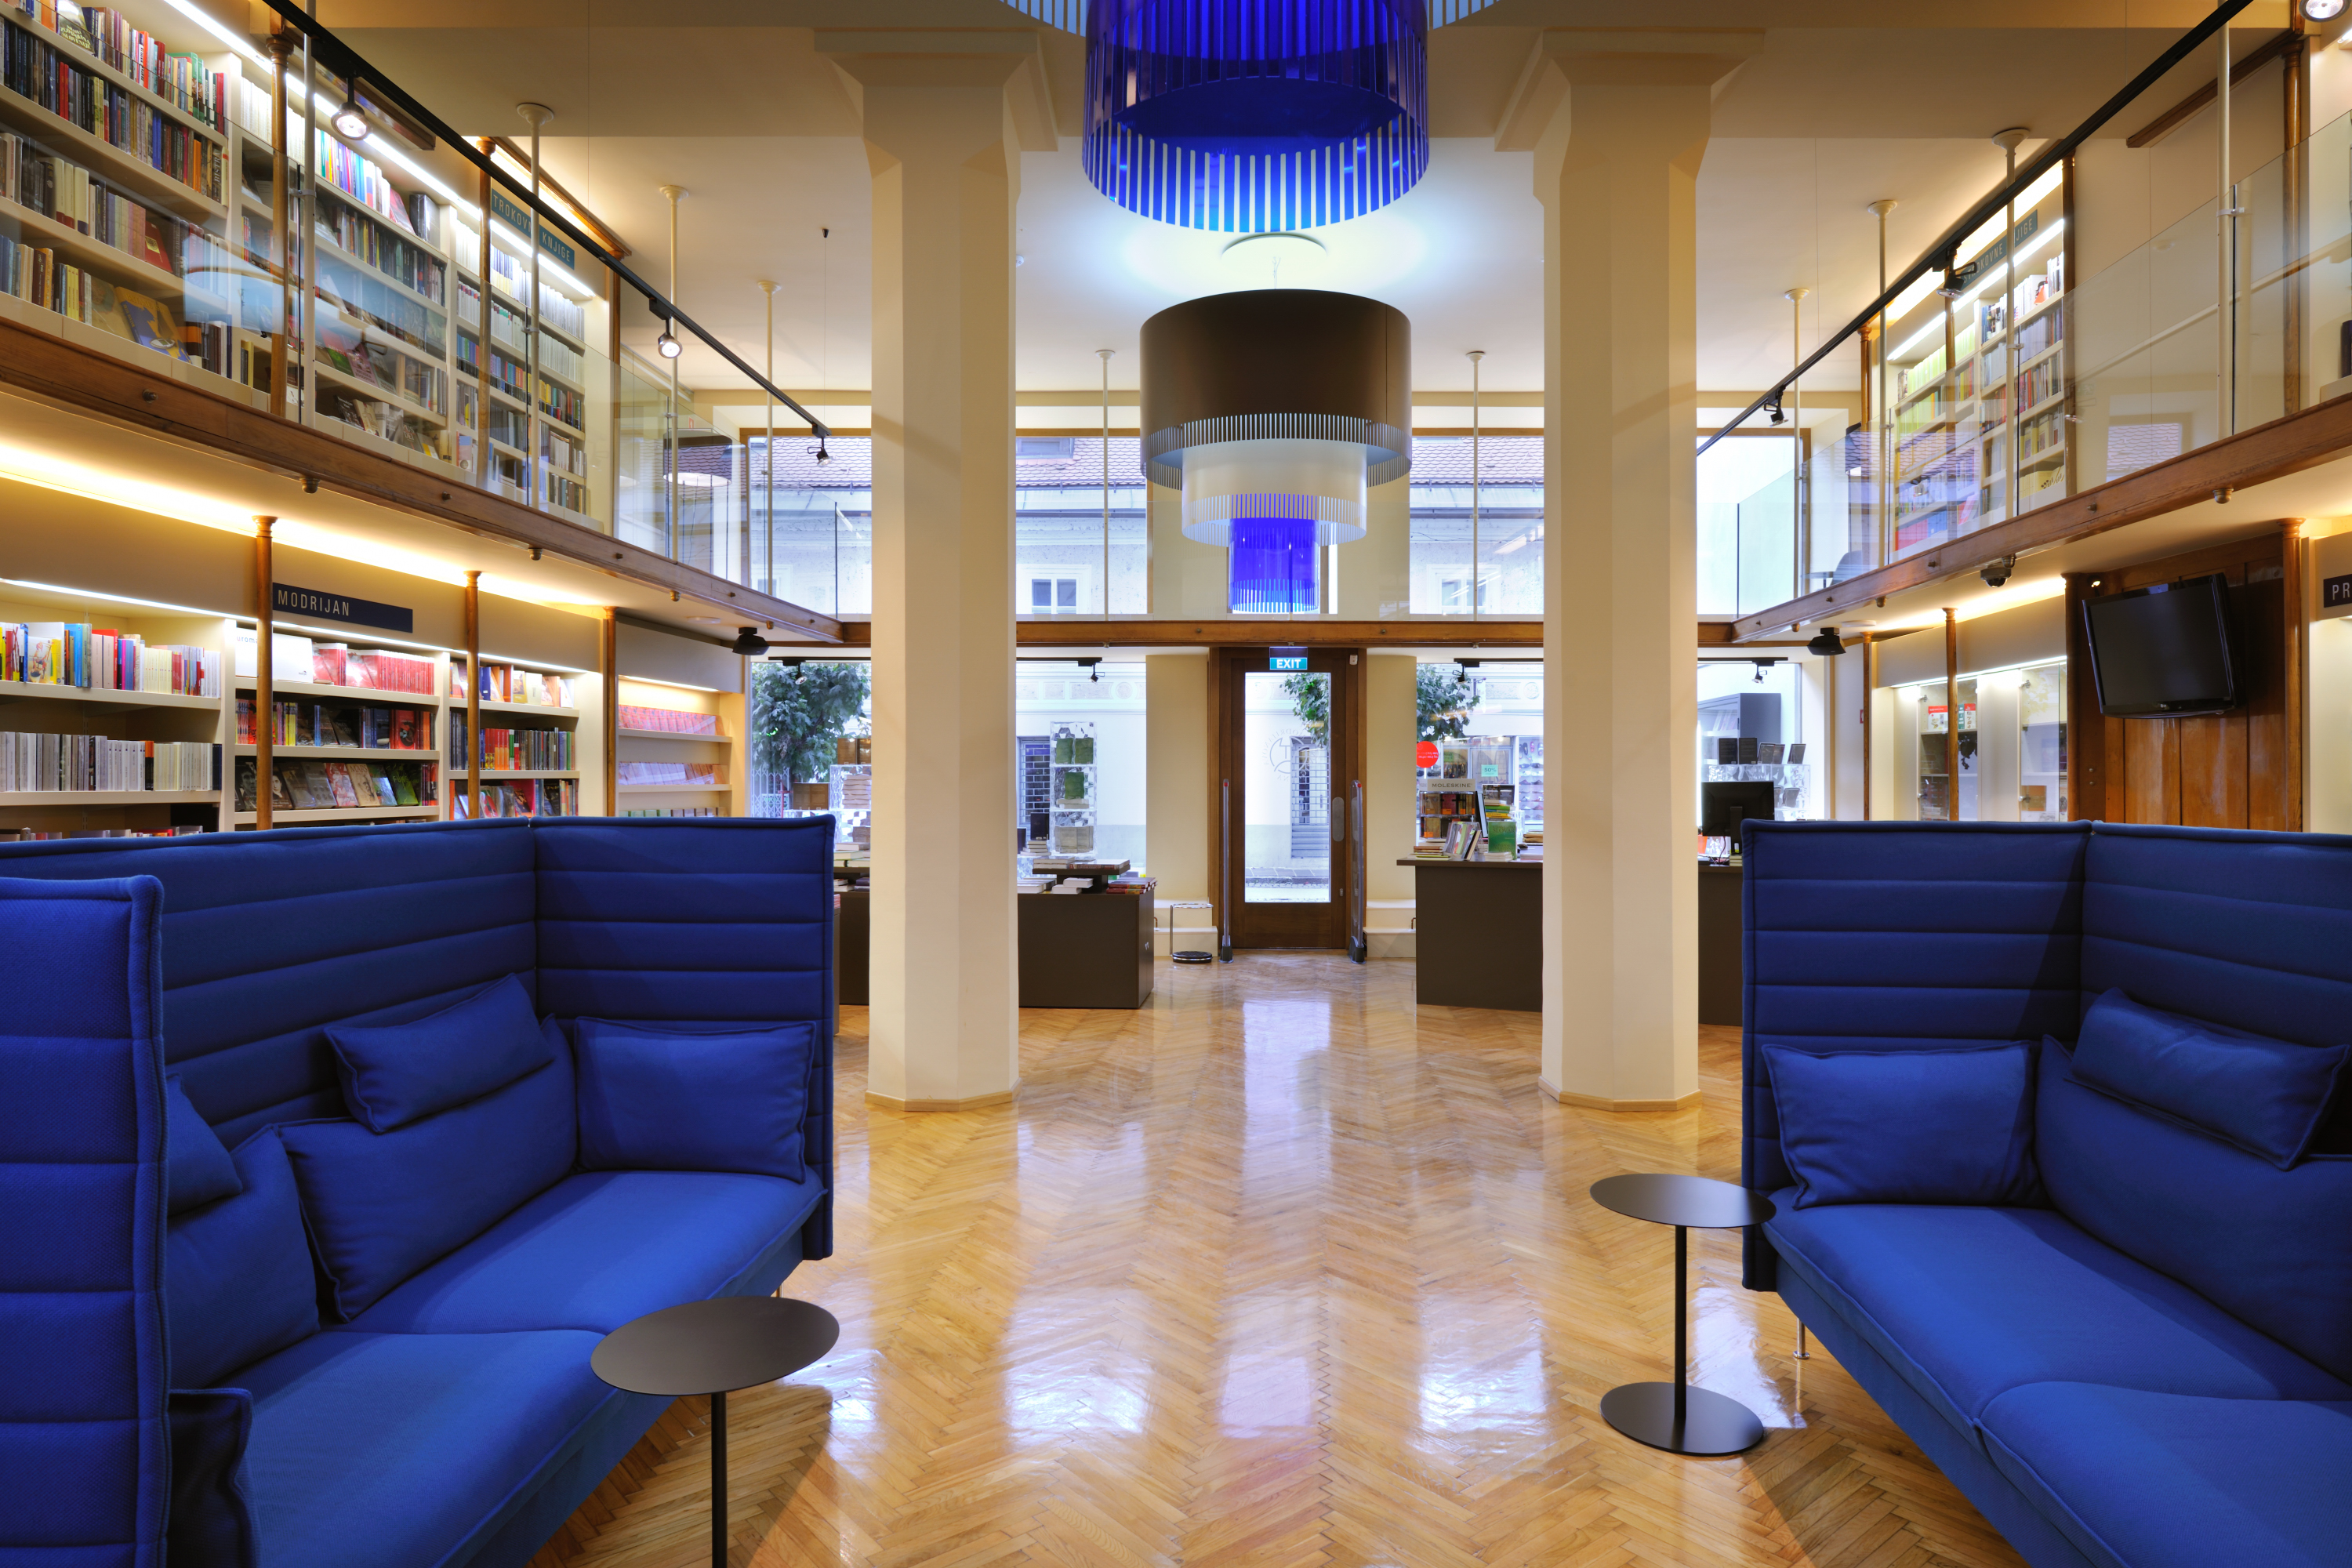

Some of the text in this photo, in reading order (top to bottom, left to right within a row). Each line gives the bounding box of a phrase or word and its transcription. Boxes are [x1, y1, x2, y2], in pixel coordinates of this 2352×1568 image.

[493, 194, 571, 263] TROKOVN KNJIGE
[2016, 218, 2033, 241] JIGE
[2332, 582, 2350, 601] PR
[278, 590, 350, 616] MODRIJAN
[237, 635, 257, 644] urom
[1276, 659, 1301, 669] EXIT
